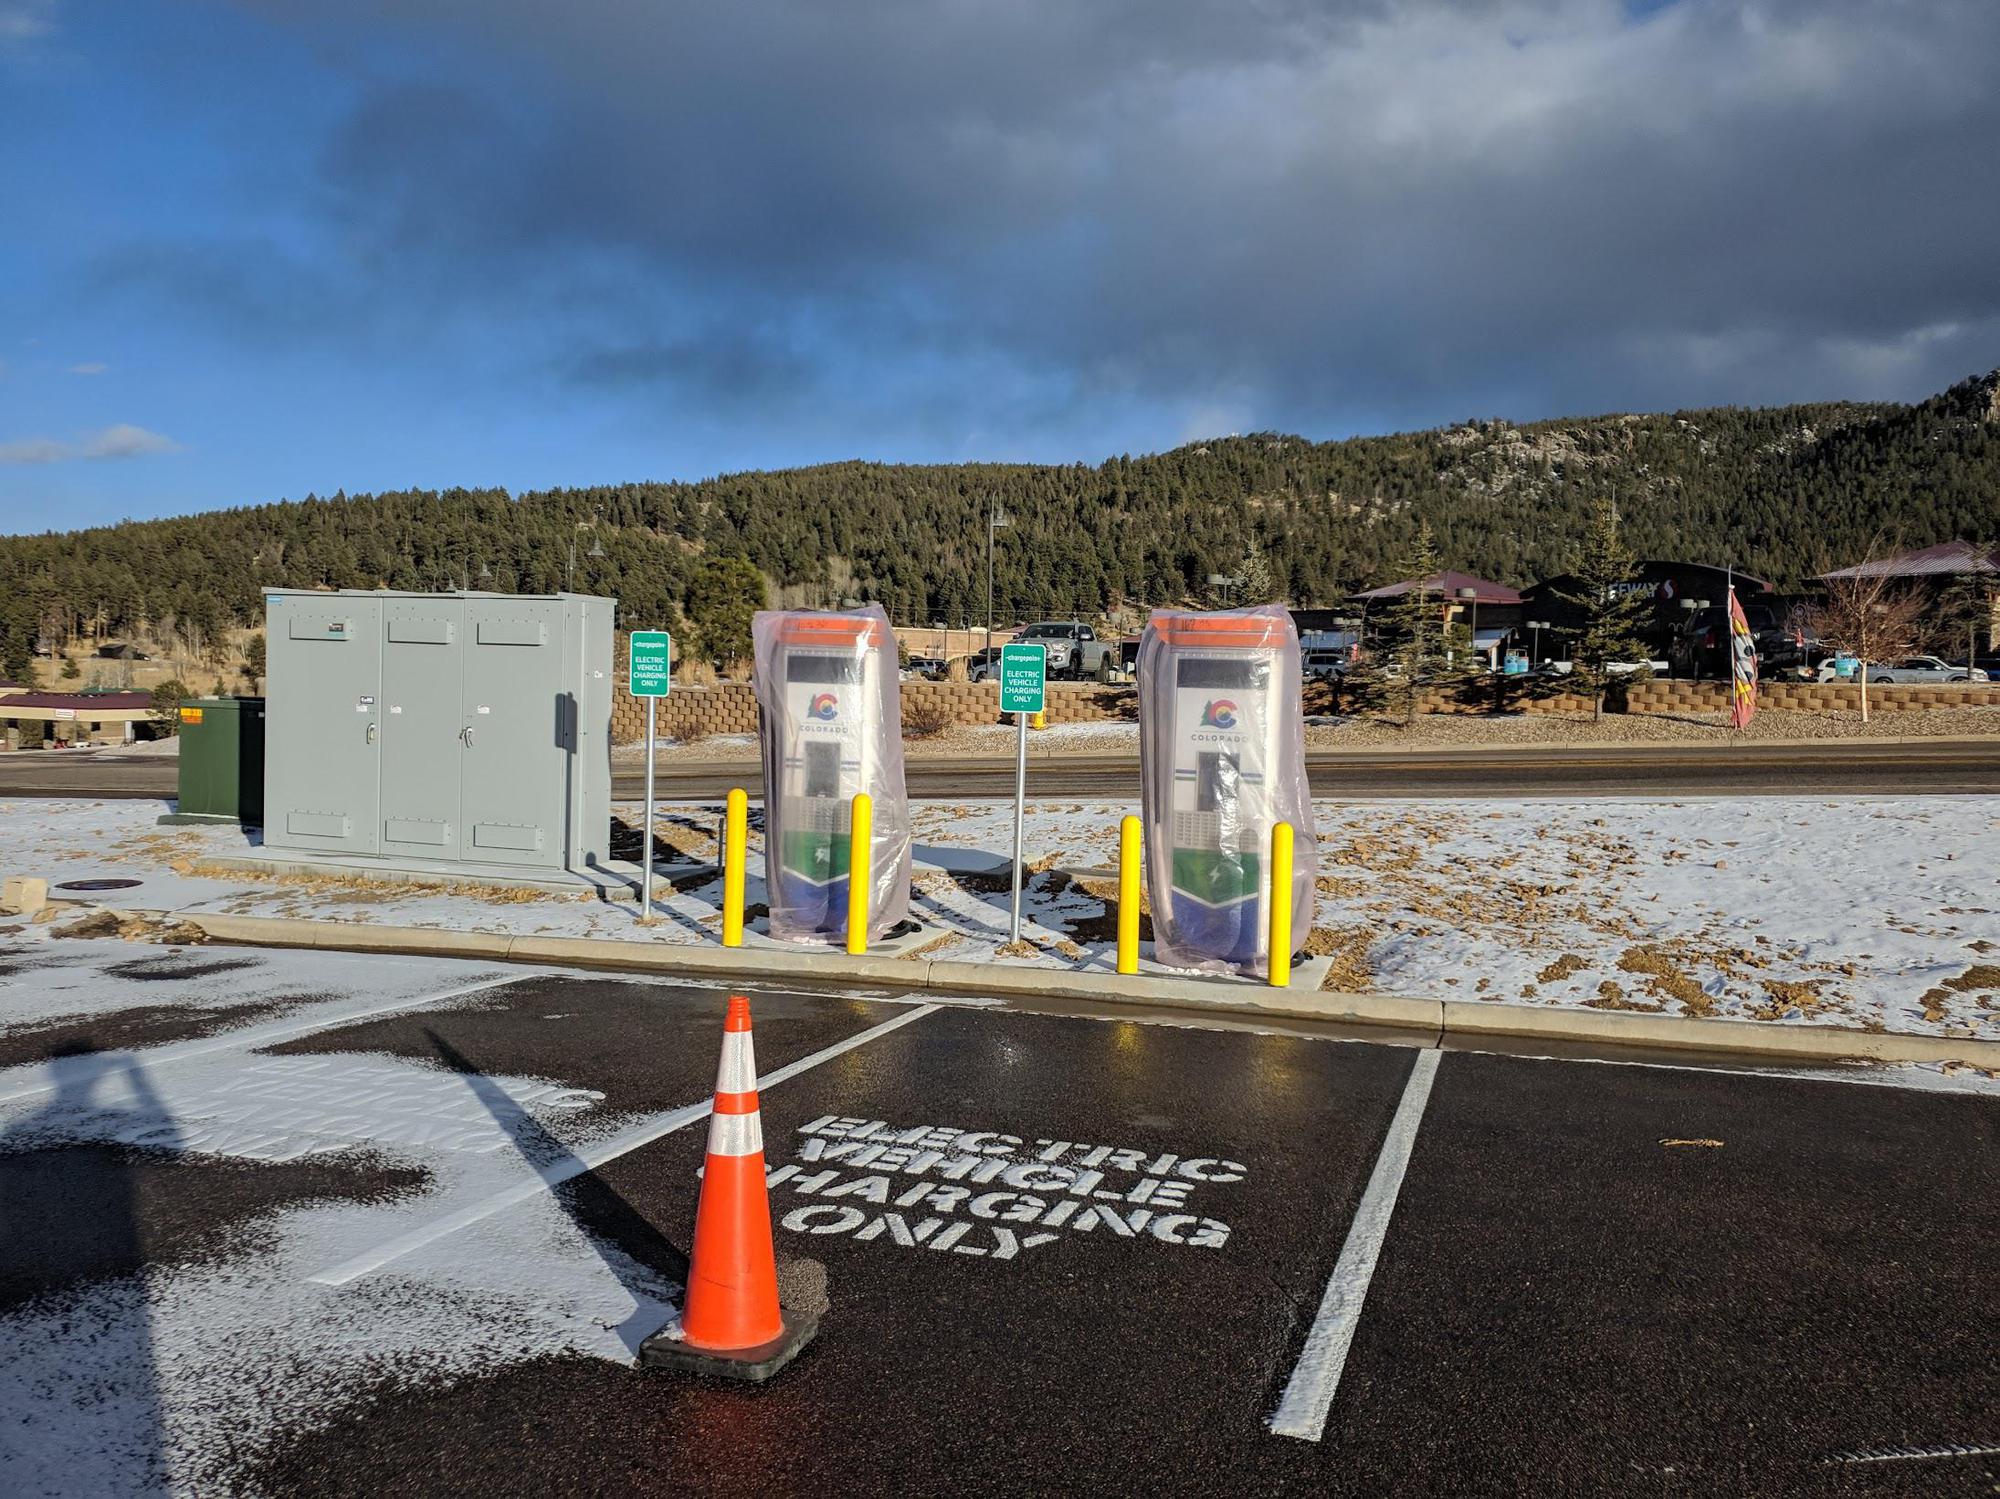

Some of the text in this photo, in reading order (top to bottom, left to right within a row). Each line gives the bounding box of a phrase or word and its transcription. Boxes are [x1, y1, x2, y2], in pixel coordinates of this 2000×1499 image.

[633, 671, 666, 679] CHARGING
[635, 656, 665, 664] ELECTRIC
[1006, 670, 1040, 678] ELECTRIC
[1004, 687, 1041, 695] CHARGING
[798, 1115, 1247, 1182] ELECTRIC
[799, 1138, 1195, 1207] VEHICLE
[696, 1163, 1231, 1248] HARGING
[781, 1205, 1060, 1259] ONLY
